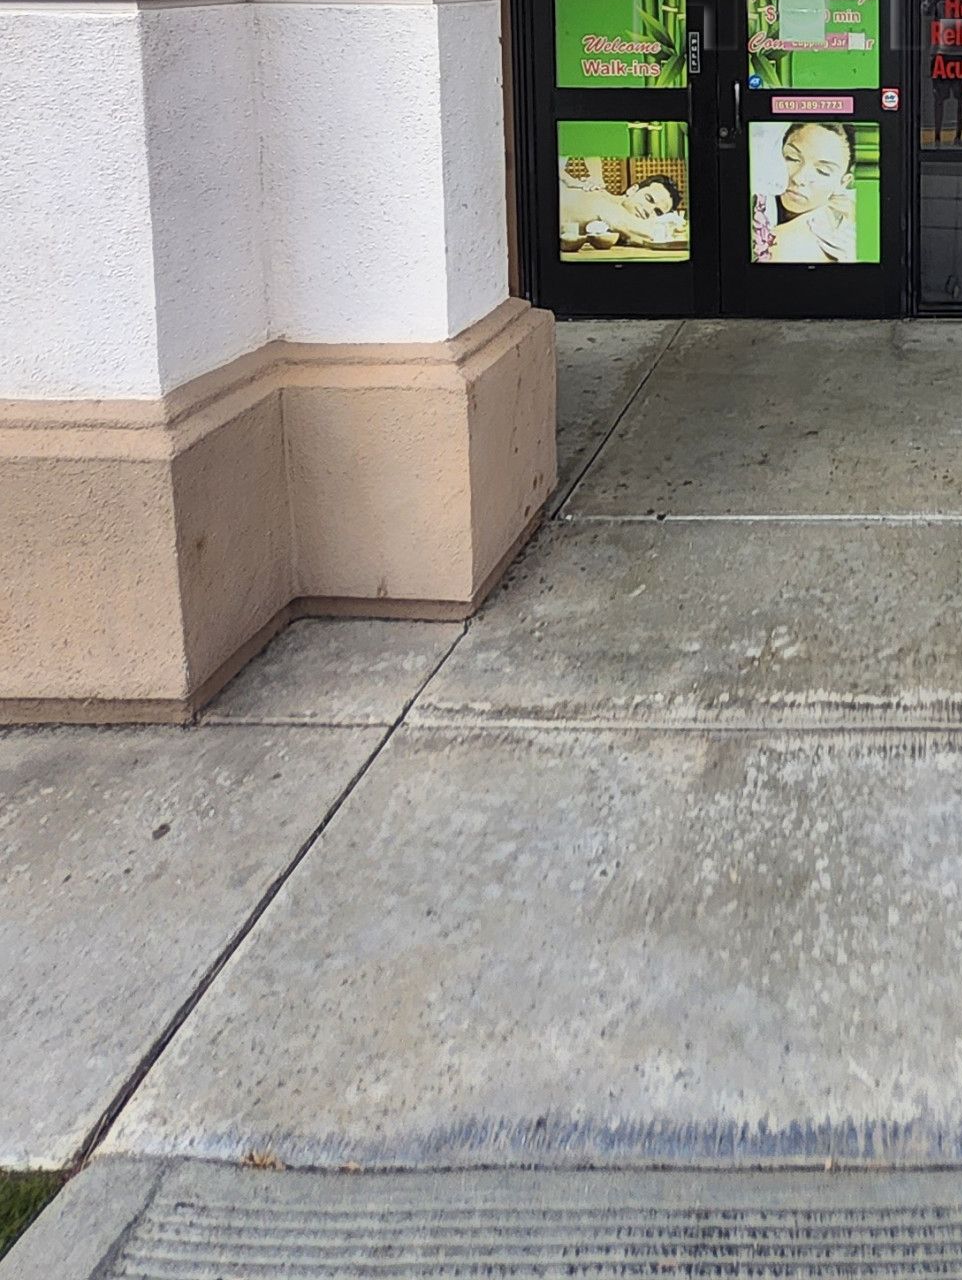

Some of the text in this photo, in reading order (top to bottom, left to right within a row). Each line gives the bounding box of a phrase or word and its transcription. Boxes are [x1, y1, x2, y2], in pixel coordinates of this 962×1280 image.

[833, 10, 861, 23] min
[582, 34, 662, 54] Welcome
[831, 37, 847, 48] Jar
[581, 60, 660, 77] Walk-ins
